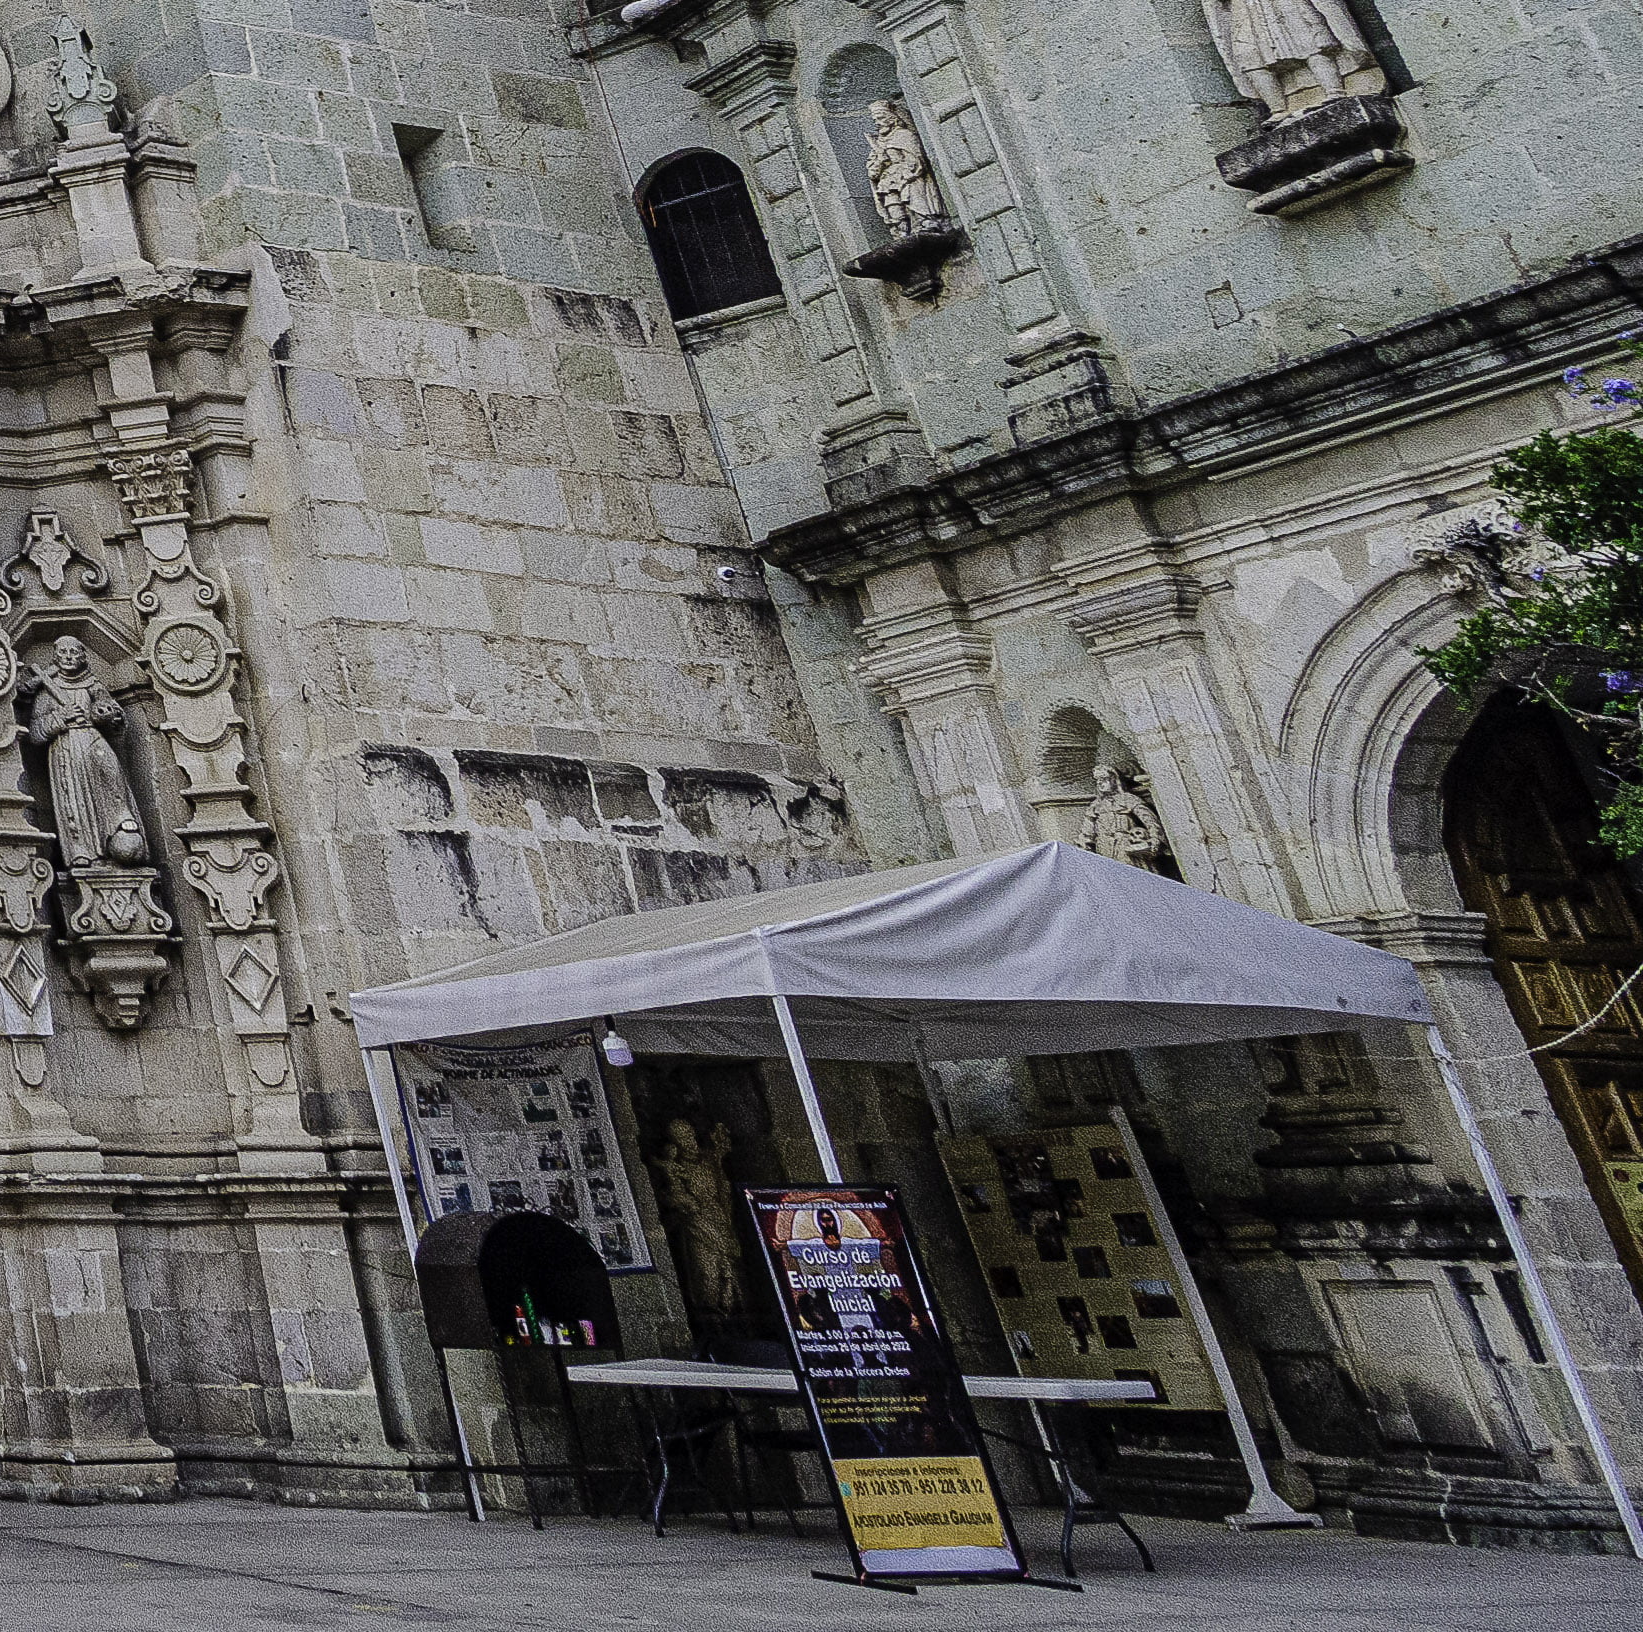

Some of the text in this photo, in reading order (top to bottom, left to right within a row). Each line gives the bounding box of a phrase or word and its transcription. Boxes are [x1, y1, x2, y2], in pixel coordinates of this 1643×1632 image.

[802, 1248, 870, 1265] Curso de
[787, 1269, 902, 1292] Evangelización
[828, 1294, 876, 1313] Inicial
[853, 1467, 911, 1478] Inscripciones
[871, 1479, 887, 1495] 124
[901, 1479, 913, 1495] 70
[919, 1479, 938, 1495] 951
[971, 1478, 985, 1494] 12
[852, 1514, 907, 1528] APOSTOLADO
[949, 1509, 994, 1525] GAUDIUM
